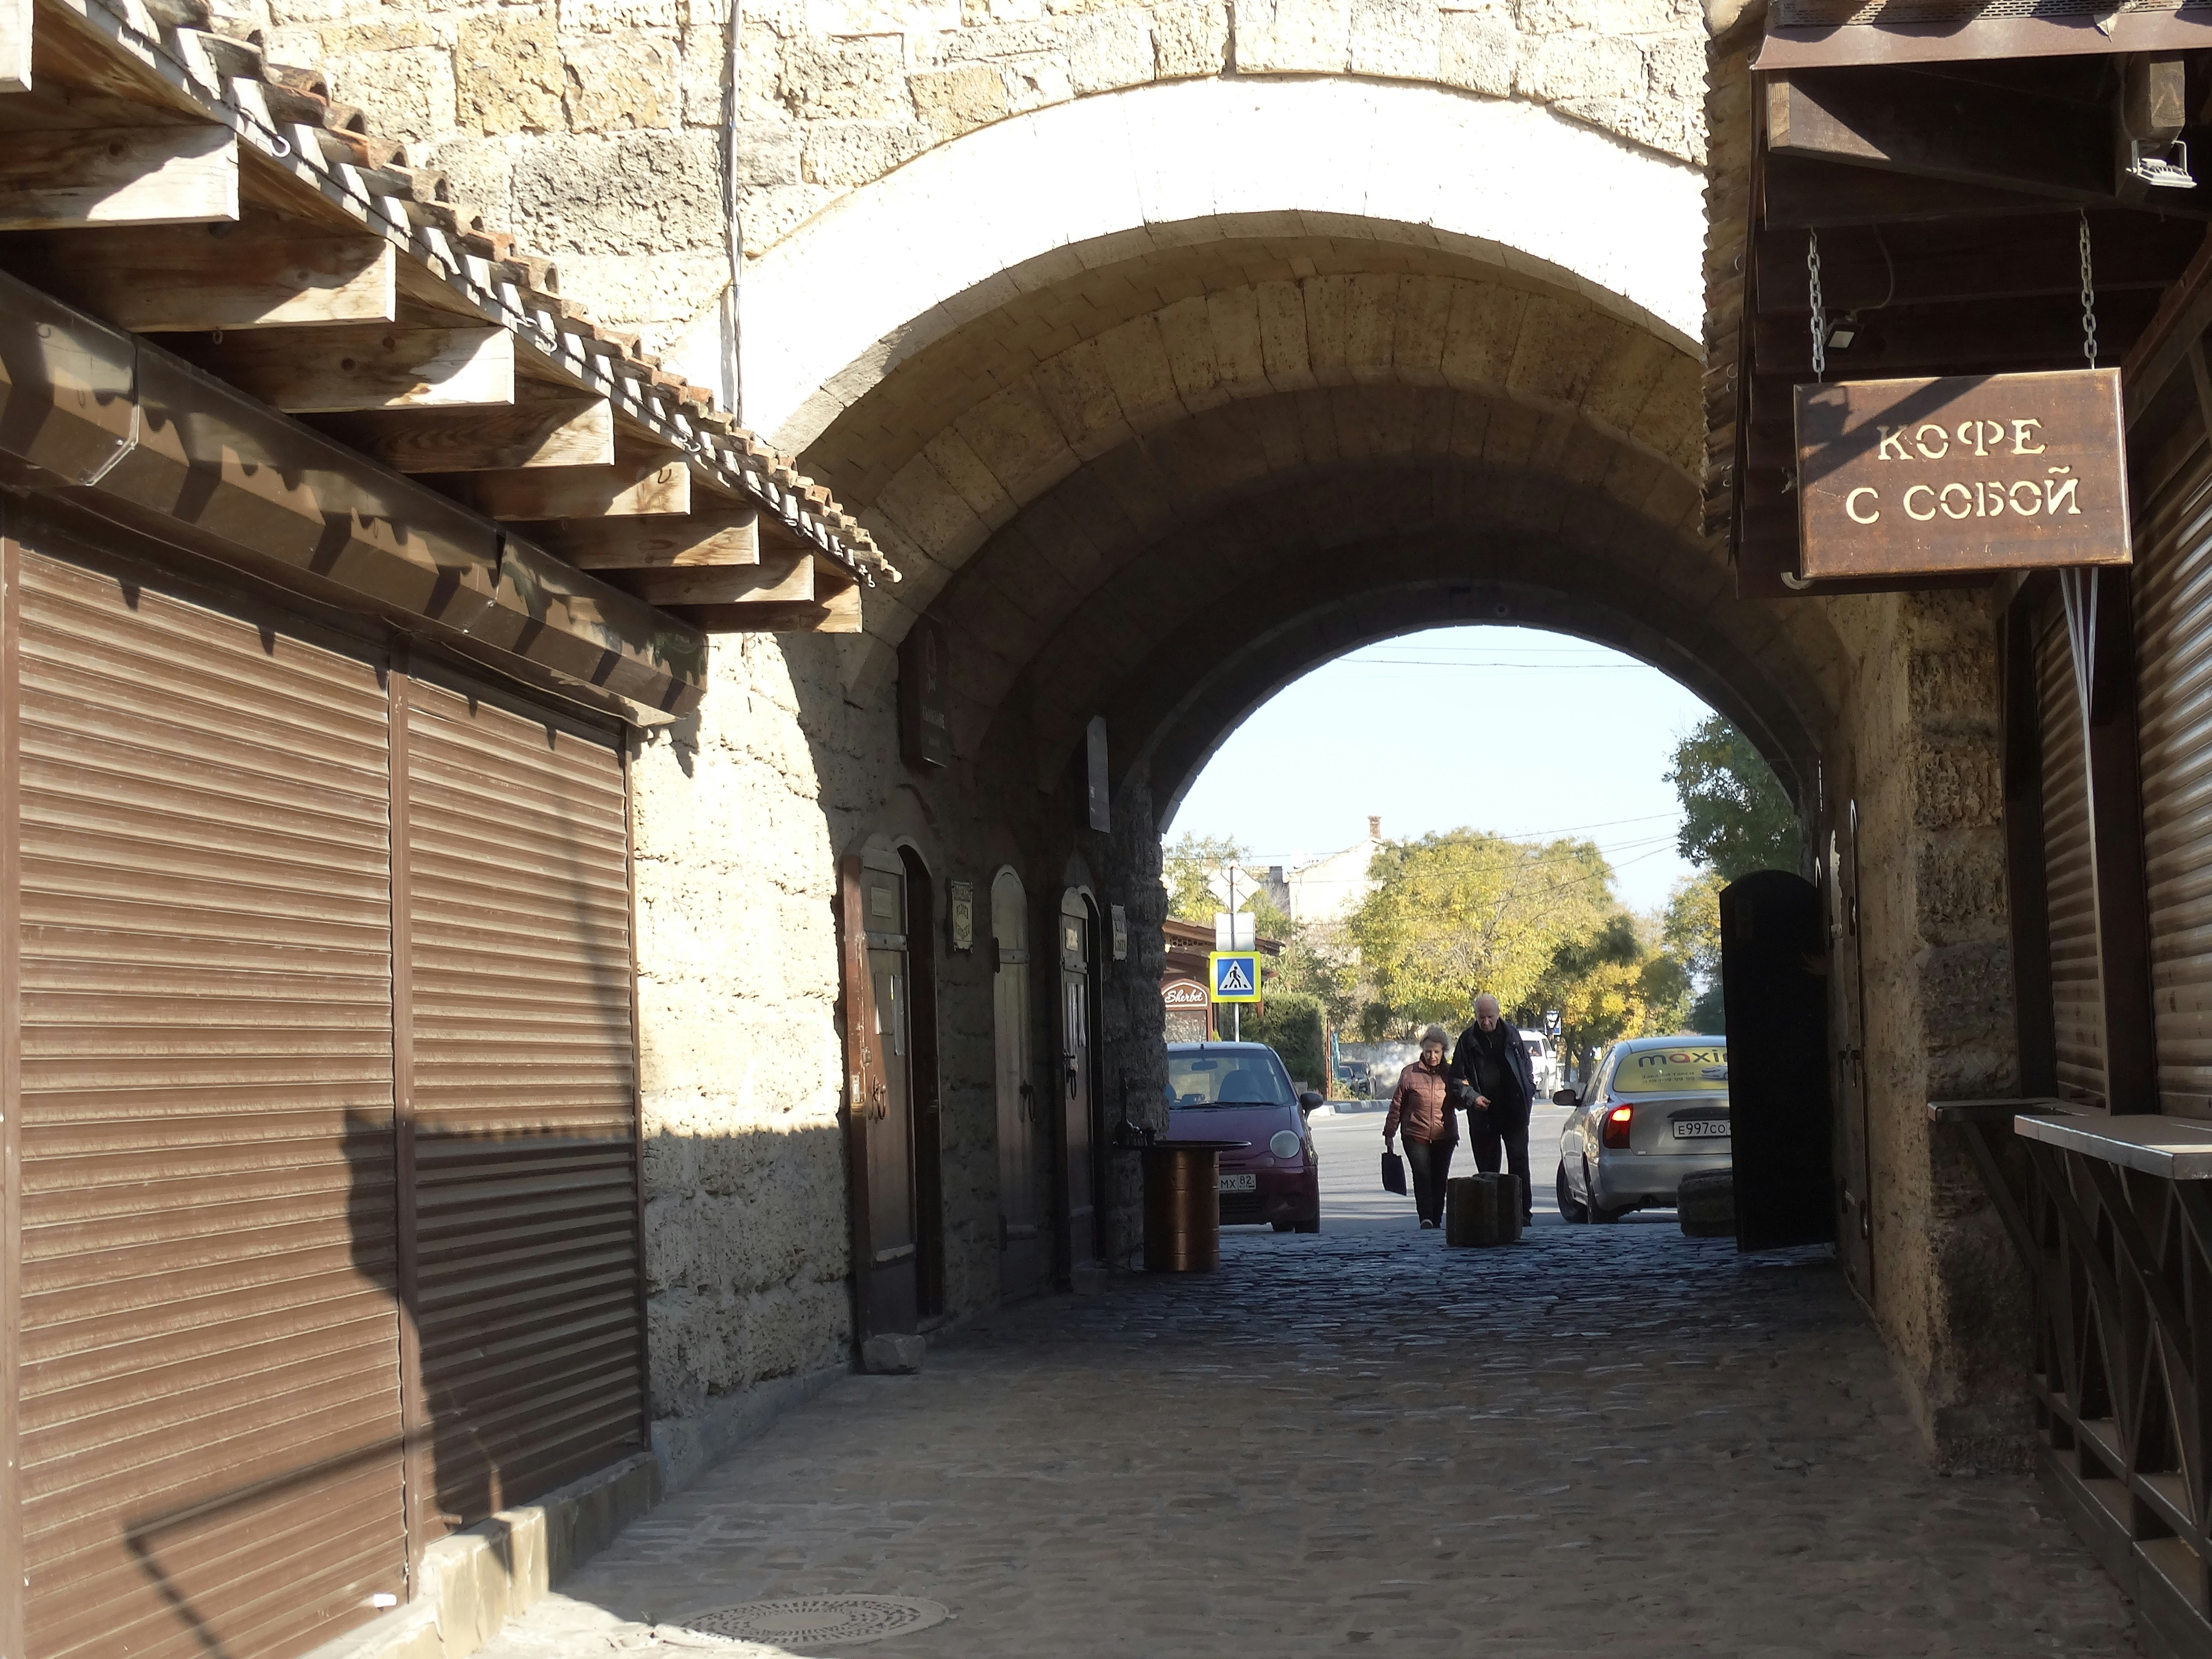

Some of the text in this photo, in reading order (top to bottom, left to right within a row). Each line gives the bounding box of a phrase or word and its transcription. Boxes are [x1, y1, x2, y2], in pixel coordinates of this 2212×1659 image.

[1877, 418, 2046, 461] КОФЕ
[1845, 465, 2081, 524] С СОБОЙ
[1164, 989, 1203, 1003] Sherbet
[1638, 1049, 1728, 1068] maxi
[1240, 1176, 1252, 1185] 82
